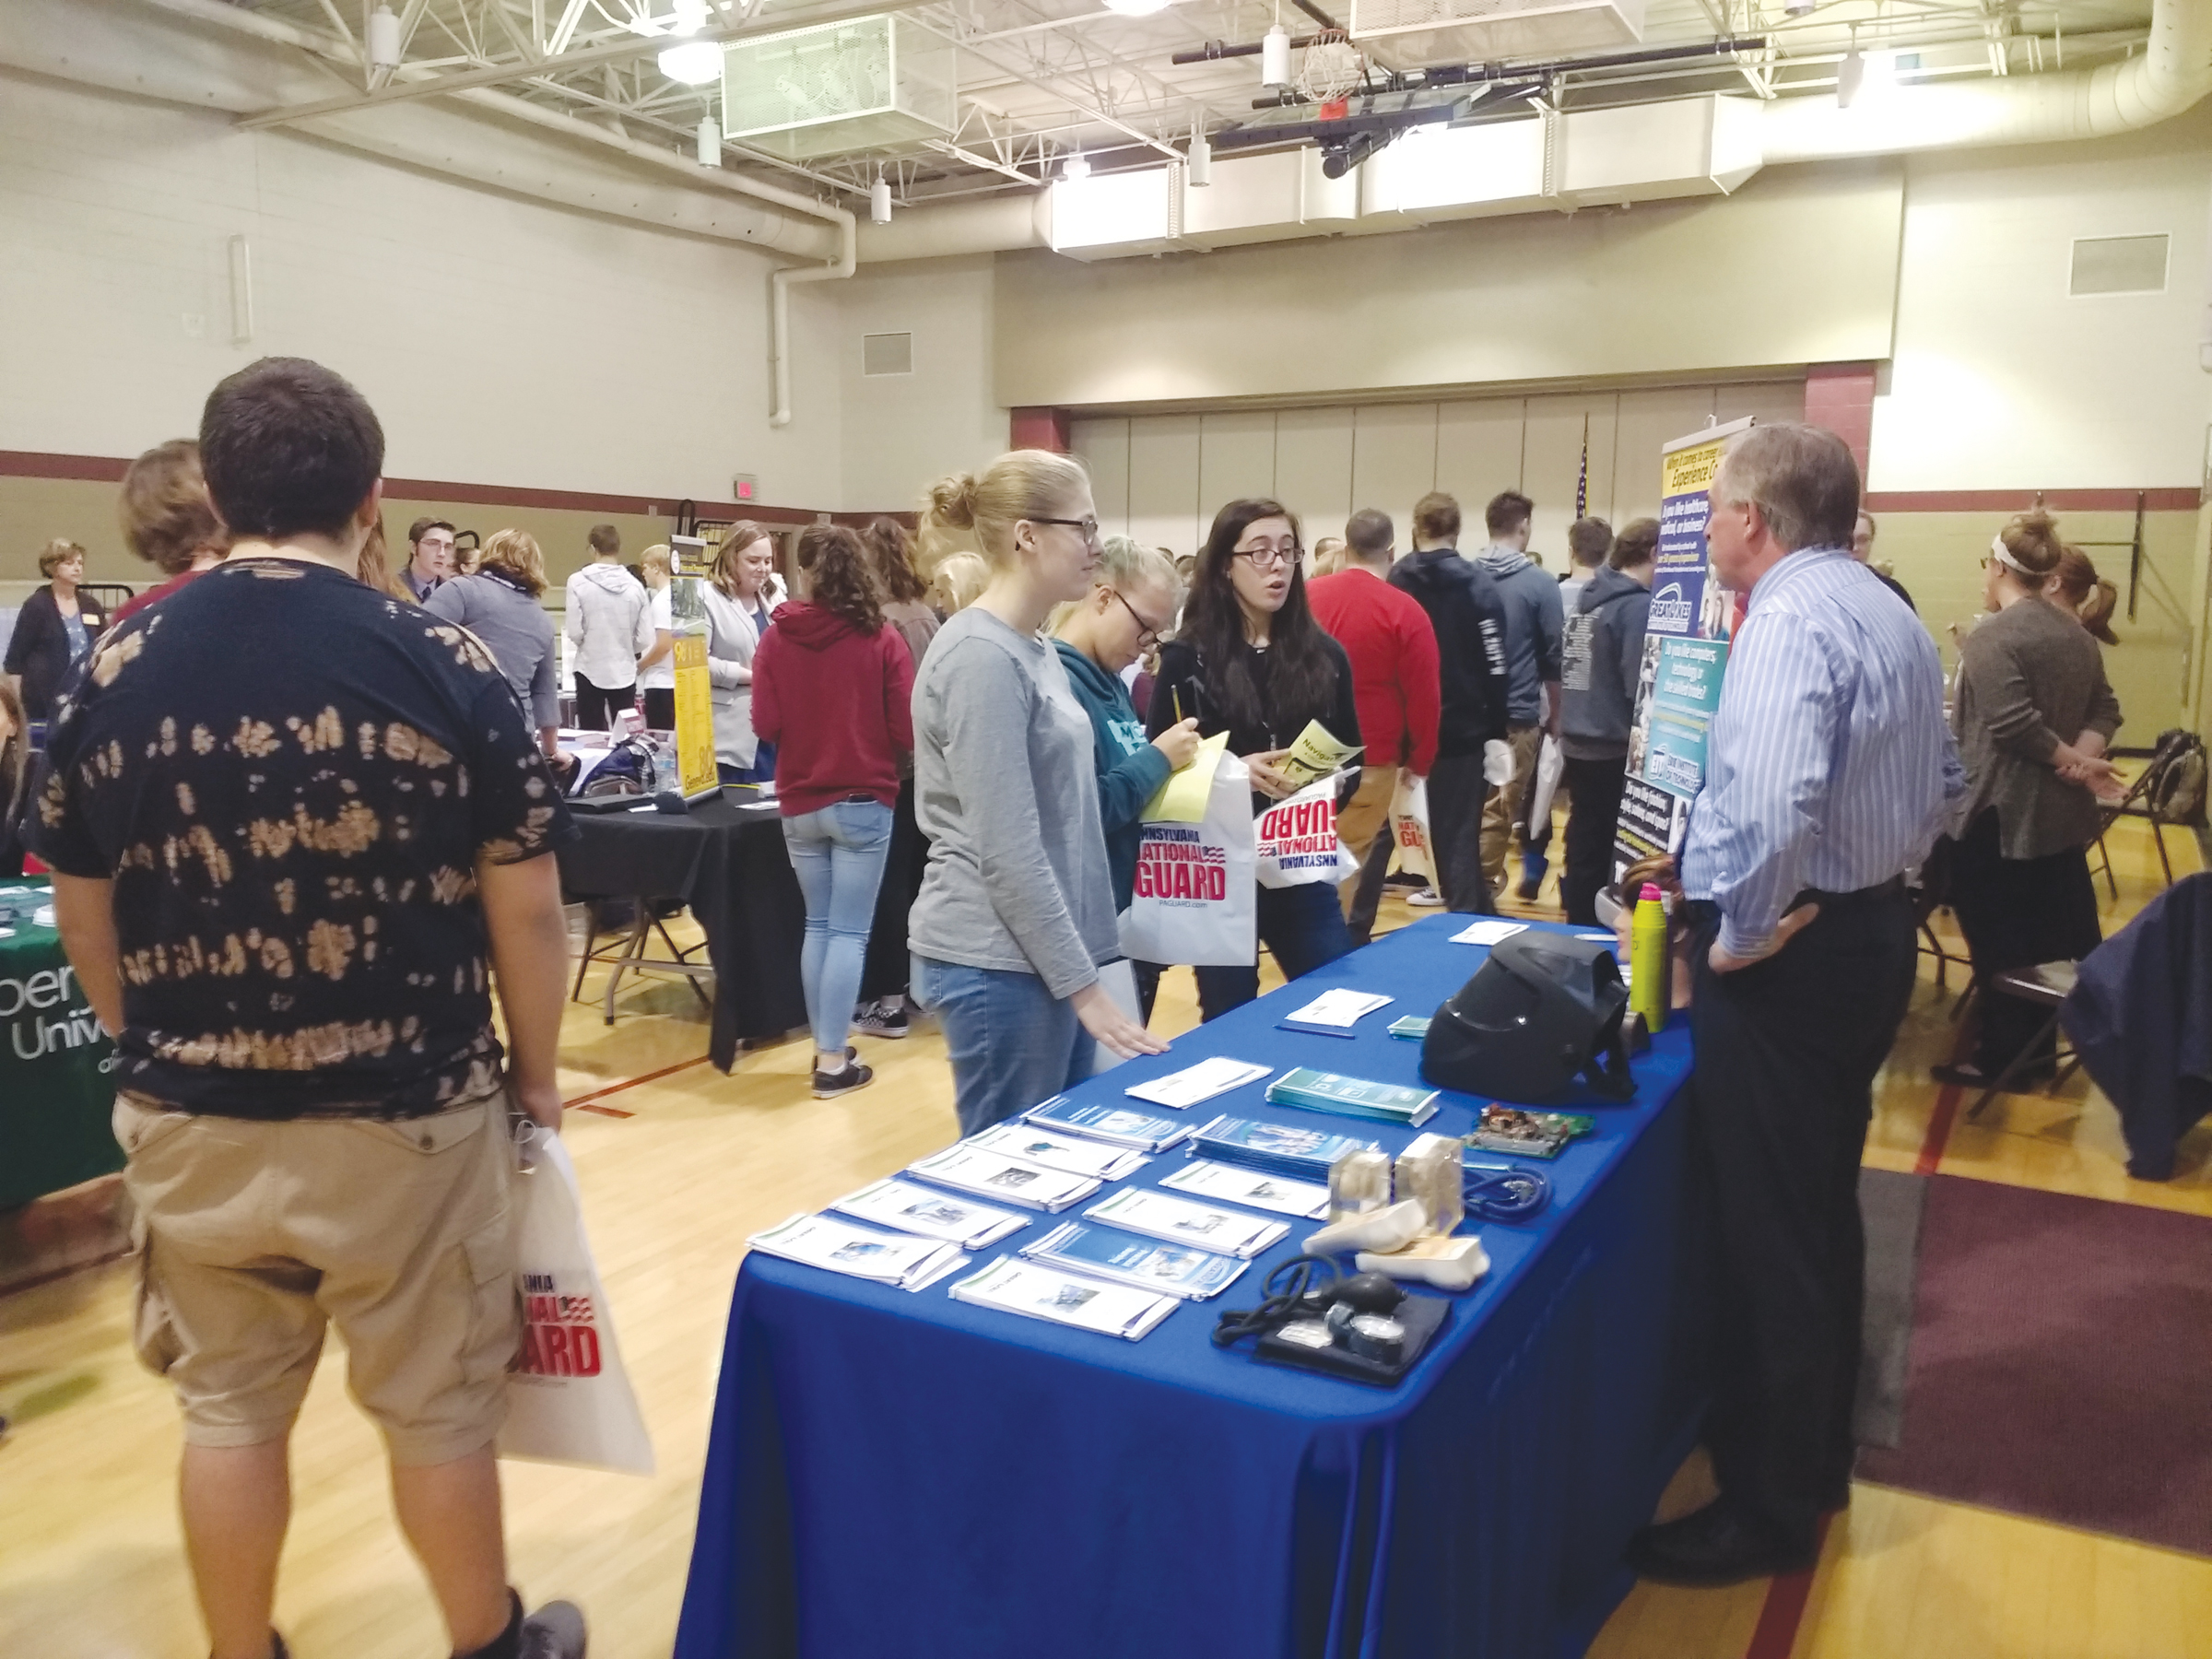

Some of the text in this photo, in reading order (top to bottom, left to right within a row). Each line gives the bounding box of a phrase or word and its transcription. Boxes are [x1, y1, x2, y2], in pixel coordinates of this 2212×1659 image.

[1672, 465, 1709, 492] Experience
[1137, 842, 1205, 864] ATIONAL
[1134, 861, 1225, 901] GUARD
[12, 1015, 110, 1060] Univ
